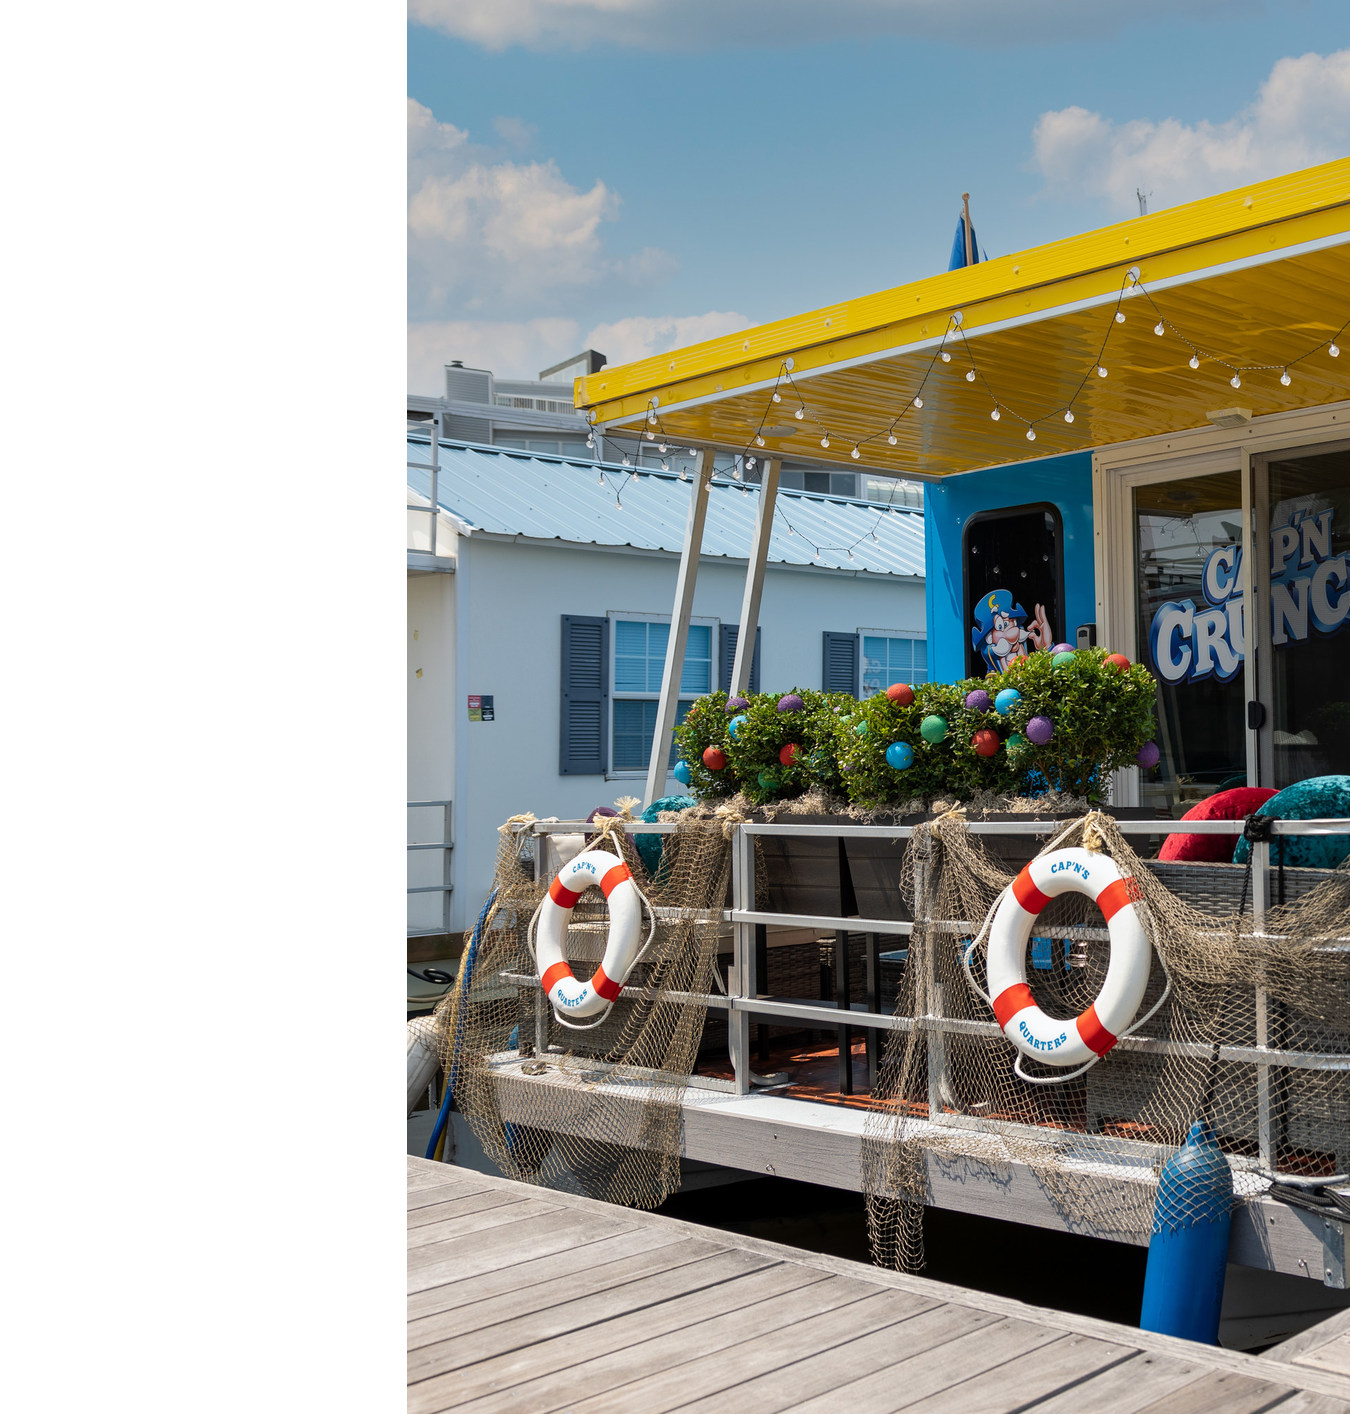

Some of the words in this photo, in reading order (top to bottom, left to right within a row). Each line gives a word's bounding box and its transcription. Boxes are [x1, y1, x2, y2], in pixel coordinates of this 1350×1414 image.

[572, 861, 596, 874] CAP'N'S
[1051, 861, 1090, 880] CAP'N'S
[557, 989, 588, 1007] QUARTERS
[1019, 1021, 1067, 1051] QUARTERS
